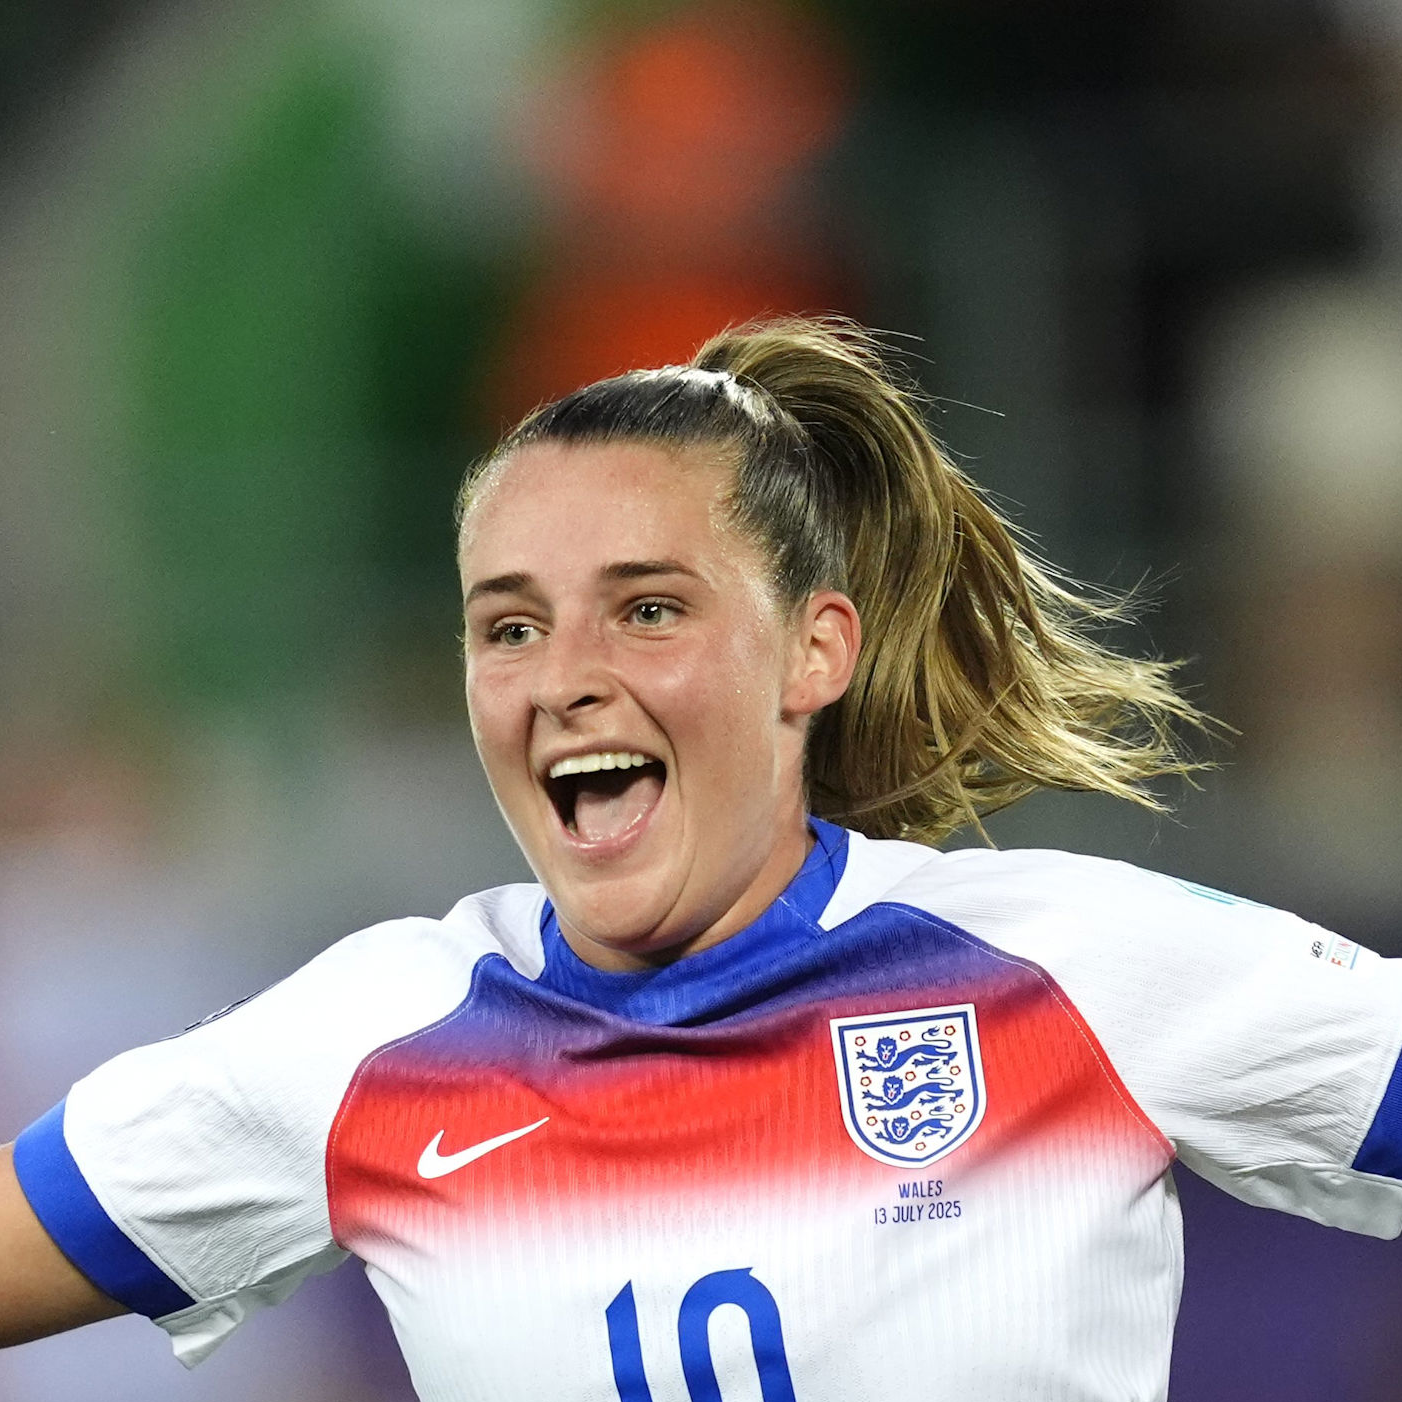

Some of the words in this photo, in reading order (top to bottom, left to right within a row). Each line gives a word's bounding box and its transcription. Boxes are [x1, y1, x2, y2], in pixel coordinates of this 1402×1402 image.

[898, 1179, 943, 1199] WALES
[874, 1207, 887, 1225] 13
[892, 1205, 924, 1223] JULY
[928, 1200, 962, 1220] 2025
